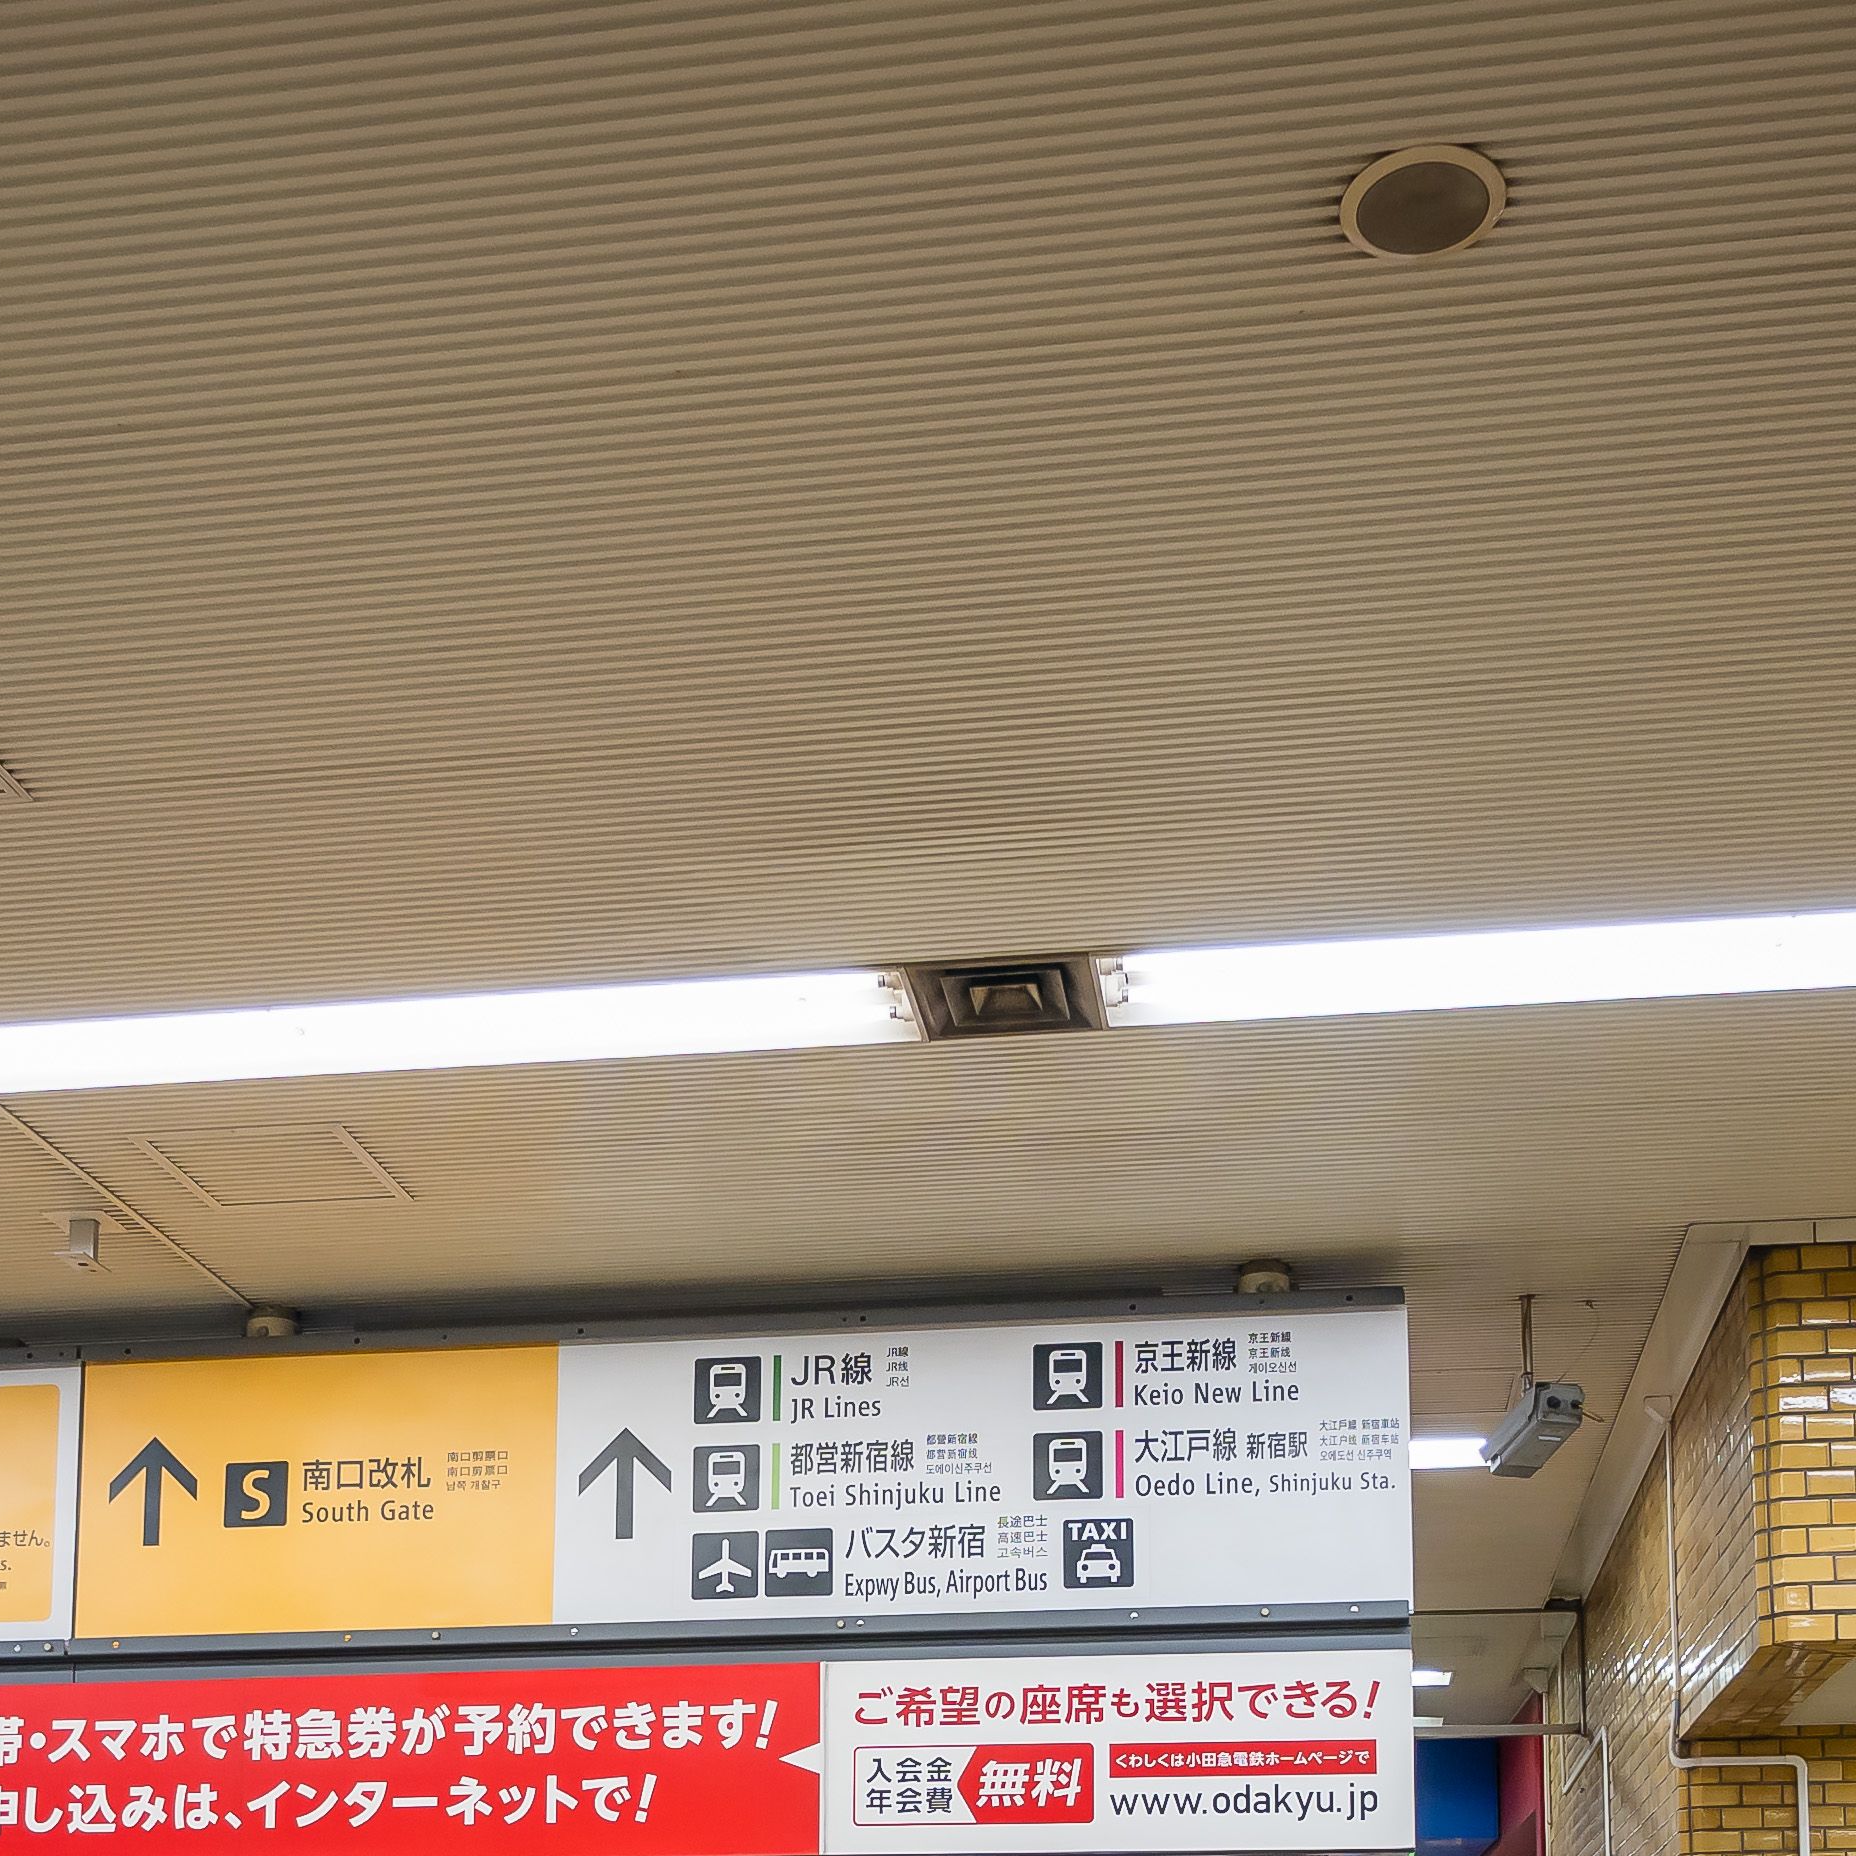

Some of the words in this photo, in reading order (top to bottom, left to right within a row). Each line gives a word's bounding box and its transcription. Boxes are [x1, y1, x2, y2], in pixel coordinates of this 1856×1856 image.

[790, 1352, 872, 1387] JR線
[1134, 1338, 1237, 1374] 京王新線
[1133, 1382, 1184, 1406] Keio
[1194, 1383, 1242, 1404] New
[1251, 1379, 1300, 1403] Line
[790, 1398, 815, 1425] JR
[824, 1395, 881, 1419] Lines
[790, 1439, 915, 1476] 都営新宿線
[1134, 1427, 1238, 1464] 大江戸線
[1246, 1431, 1308, 1461] 新宿駅
[302, 1457, 431, 1491] 南口改札
[1135, 1473, 1195, 1497] Oedo
[1206, 1471, 1261, 1498] Line,
[1269, 1472, 1352, 1496] Shinjuku
[1359, 1471, 1397, 1490] Sta.
[301, 1499, 373, 1524] South
[380, 1499, 434, 1521] Gate
[790, 1484, 835, 1508] Toei
[845, 1481, 944, 1510] Shinjuku
[955, 1480, 1001, 1503] Line
[845, 1523, 986, 1560] バスタ新宿
[1068, 1521, 1127, 1541] TAXI
[845, 1573, 900, 1601] Expwy
[904, 1571, 942, 1599] Bus,
[946, 1568, 1011, 1599] Airport
[1015, 1567, 1048, 1591] Bus
[854, 1680, 1381, 1728] ご希望の座席も選択できる!
[866, 1756, 953, 1783] 入会金
[1114, 1749, 1371, 1769] くわしくは小田急電鉄ホームページで
[977, 1757, 1084, 1809] 無料
[866, 1786, 954, 1815] 年会費
[1110, 1783, 1379, 1820] www.odakyu.jp
